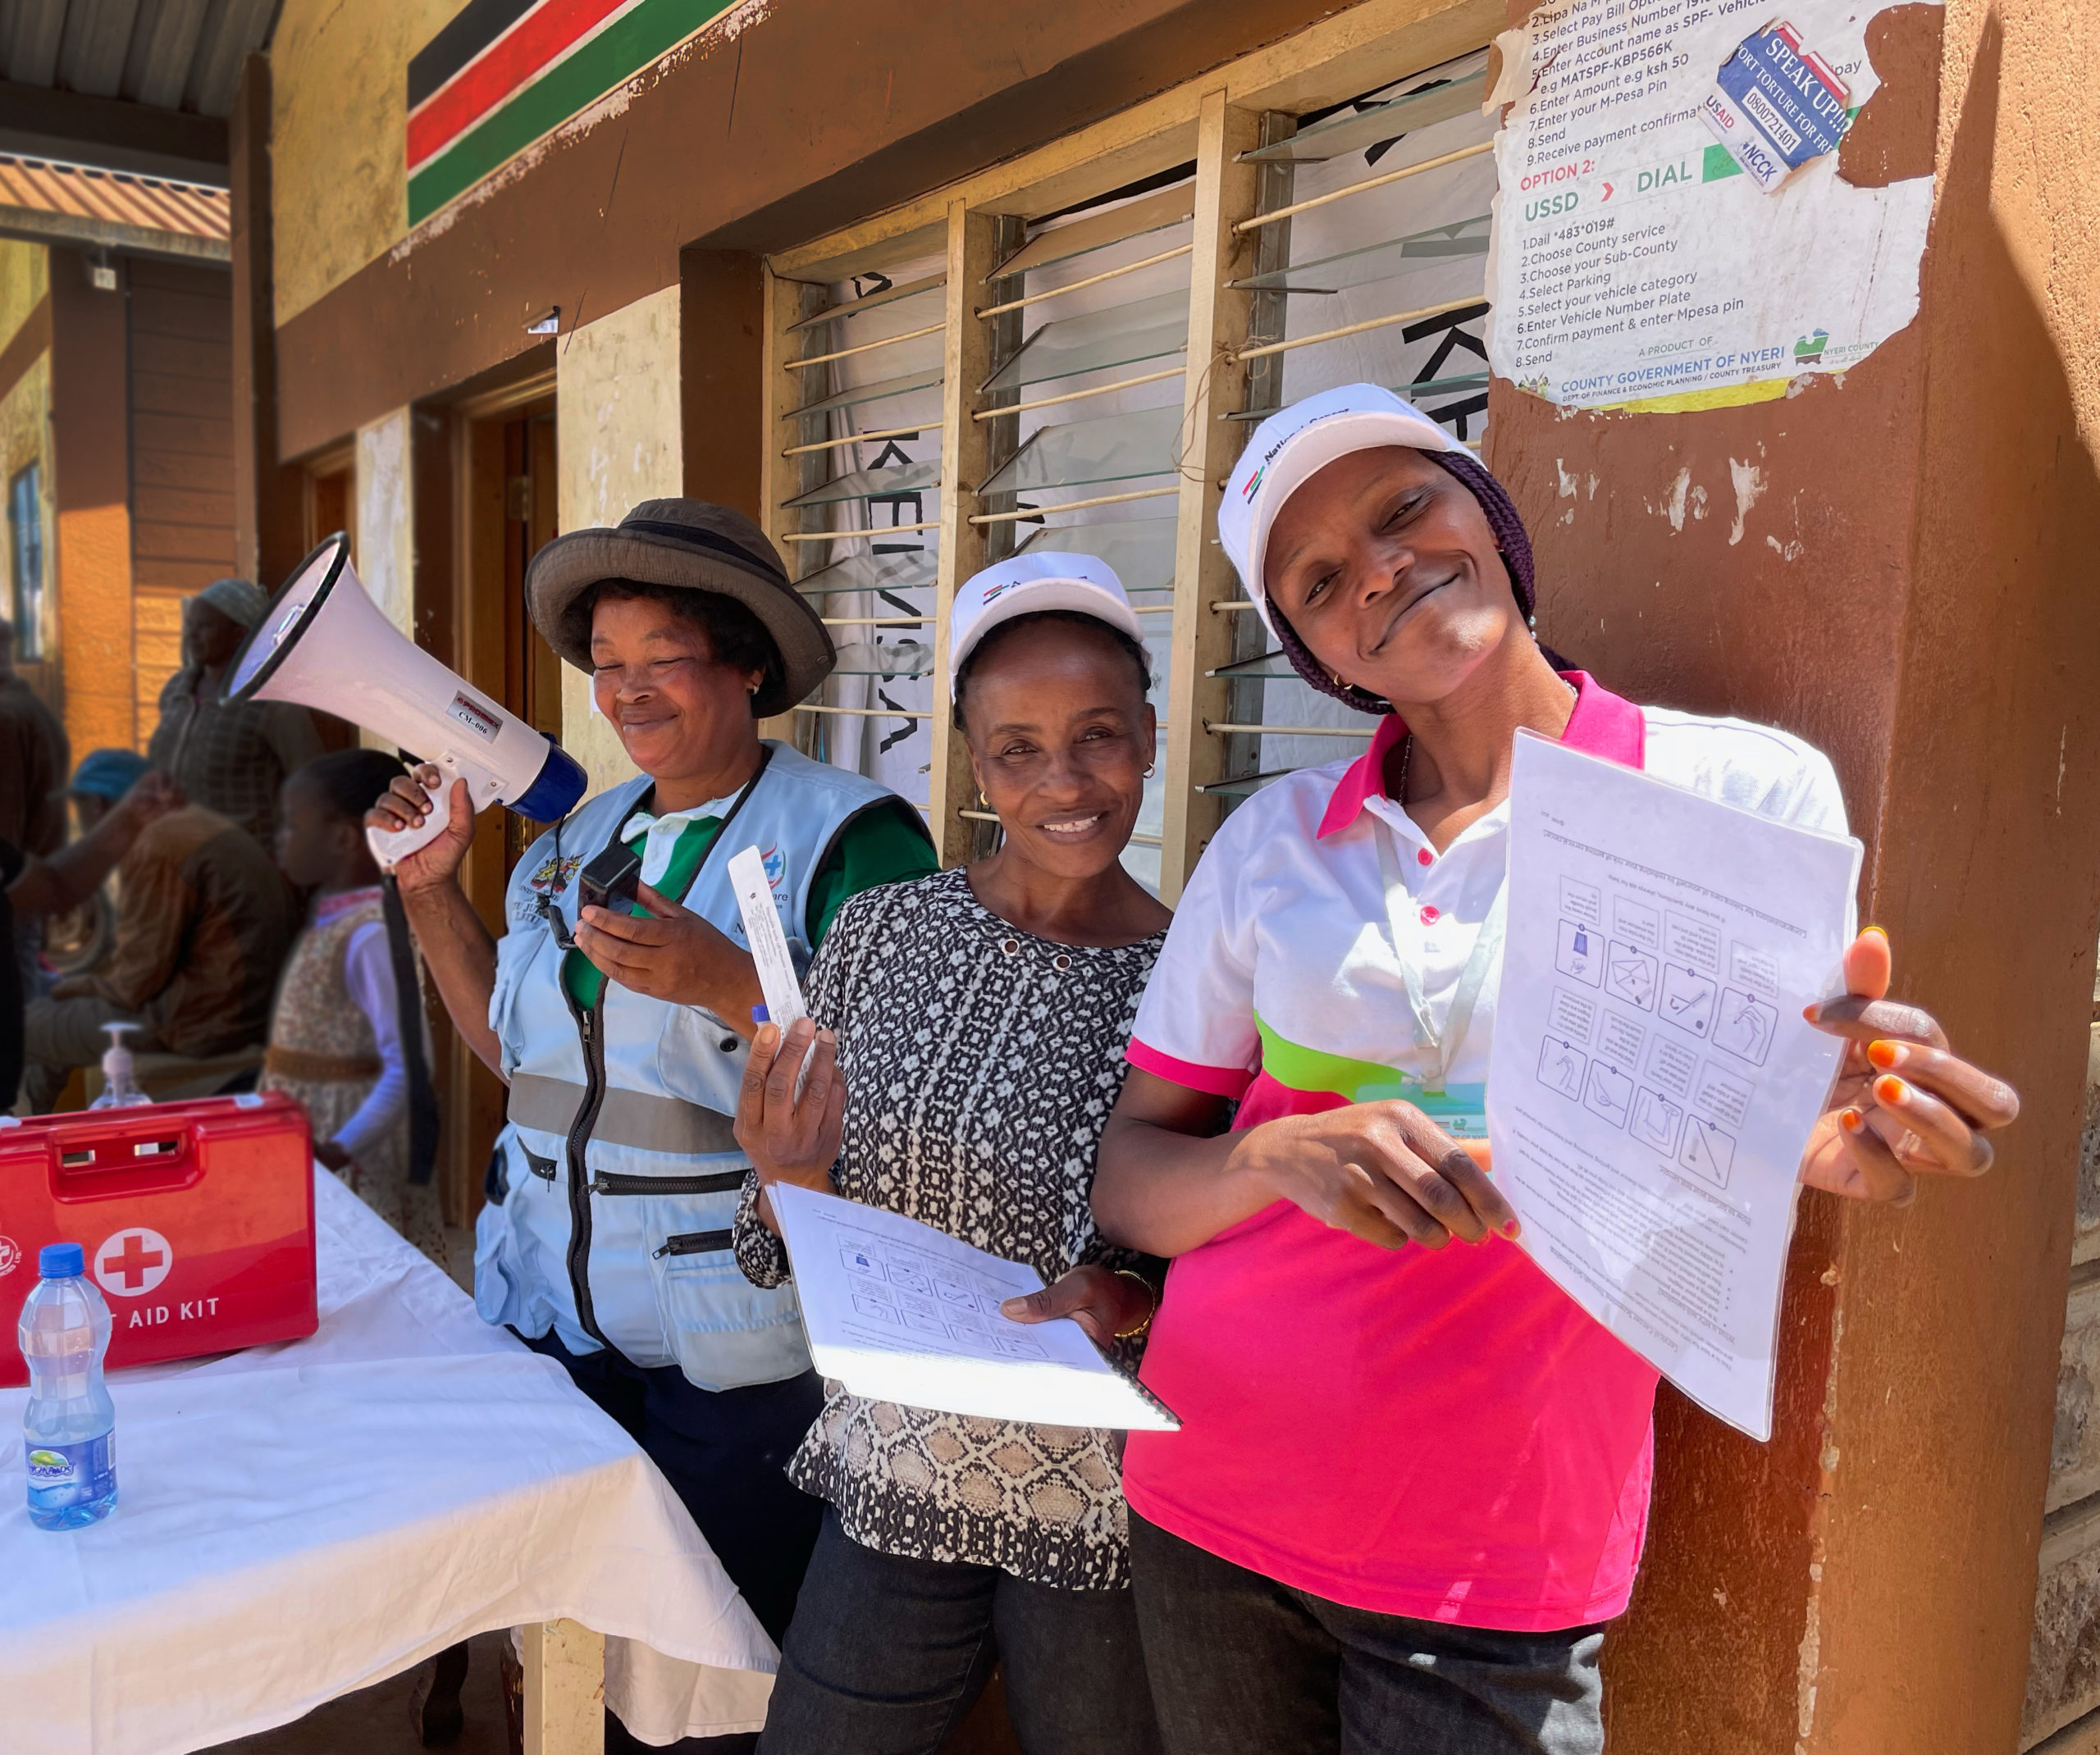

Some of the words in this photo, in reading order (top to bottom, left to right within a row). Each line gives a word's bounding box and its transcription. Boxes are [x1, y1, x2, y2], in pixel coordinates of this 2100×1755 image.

[1532, 9, 1568, 28] 2.Lipa
[1572, 2, 1586, 15] Na
[1532, 21, 1577, 45] 3.Select
[1582, 13, 1602, 29] Pay
[1607, 2, 1624, 20] Bill
[1532, 40, 1573, 63] 4.Enter
[1577, 22, 1628, 48] Business
[1632, 3, 1682, 28] Number
[1575, 41, 1624, 66] Account
[1628, 28, 1661, 48] name
[1665, 22, 1678, 34] as
[1530, 93, 1569, 115] 6.Enter
[1573, 75, 1620, 100] Amount
[1624, 70, 1642, 86] e.g
[1646, 58, 1667, 77] ksh
[1672, 52, 1689, 69] 50
[1541, 77, 1557, 95] e.g
[1560, 40, 1673, 88] MATSPF-KBP566K
[1765, 38, 1818, 98] SPEAK
[1529, 111, 1568, 133] 7.Enter
[1571, 103, 1597, 121] your
[1600, 87, 1644, 109] M-Pesa
[1648, 80, 1667, 94] Pin
[1706, 94, 1734, 129] USAID
[1746, 93, 1796, 151] 0800721401
[1755, 67, 1800, 117] TORTURE
[1794, 114, 1817, 139] FOR
[1527, 128, 1566, 149] 8.Send
[1527, 141, 1581, 166] 9.Receive
[1584, 124, 1637, 152] payment
[1520, 163, 1577, 191] OPTION
[1582, 159, 1596, 174] 2:
[1744, 144, 1778, 183] NCCK
[1525, 191, 1579, 222] USSD
[1637, 161, 1692, 193] DIAL
[1520, 263, 1571, 285] 3.Choose
[1574, 258, 1601, 274] your
[1605, 239, 1678, 265] Sub-County
[1521, 248, 1573, 267] 2.Choose
[1576, 235, 1618, 255] County
[1621, 225, 1665, 244] service
[1522, 233, 1550, 251] 1.Dail
[1518, 299, 1562, 318] 5.Select
[1565, 294, 1591, 311] your
[1595, 281, 1637, 302] vehicle
[1641, 271, 1698, 294] category
[1519, 280, 1564, 300] 4.Select
[1567, 272, 1611, 290] Parking
[1517, 330, 1568, 351] 7.Confirm
[1572, 321, 1625, 343] payment
[1628, 317, 1637, 329] &
[1640, 312, 1673, 328] enter
[1677, 303, 1719, 321] Mpesa
[1723, 298, 1744, 317] pin
[1518, 317, 1557, 335] 6.Enter
[1560, 304, 1602, 326] Vehicle
[1605, 297, 1655, 317] Number
[1659, 290, 1691, 307] Plate
[1515, 351, 1552, 367] 8.Send
[1638, 349, 1646, 358] A
[1648, 340, 1694, 357] PRODUCT
[1699, 336, 1714, 346] OF
[1824, 347, 1846, 356] NYERI
[1847, 341, 1879, 352] COUNTY
[1562, 374, 1614, 394] COUNTY
[1618, 358, 1712, 385] GOVERNMENT
[1716, 354, 1736, 368] OF
[1740, 346, 1785, 365] NYERI
[1563, 393, 1580, 402] DEPT.
[1581, 391, 1591, 399] OF
[1591, 387, 1621, 398] FINANCE
[1628, 381, 1665, 392] ECONOMIC
[1666, 375, 1703, 387] PLANNING
[1710, 369, 1740, 379] COUNTY
[1742, 362, 1782, 375] TREASURY
[459, 711, 488, 734] CM-006
[129, 1306, 169, 1329] AID
[180, 1297, 219, 1320] KIT
